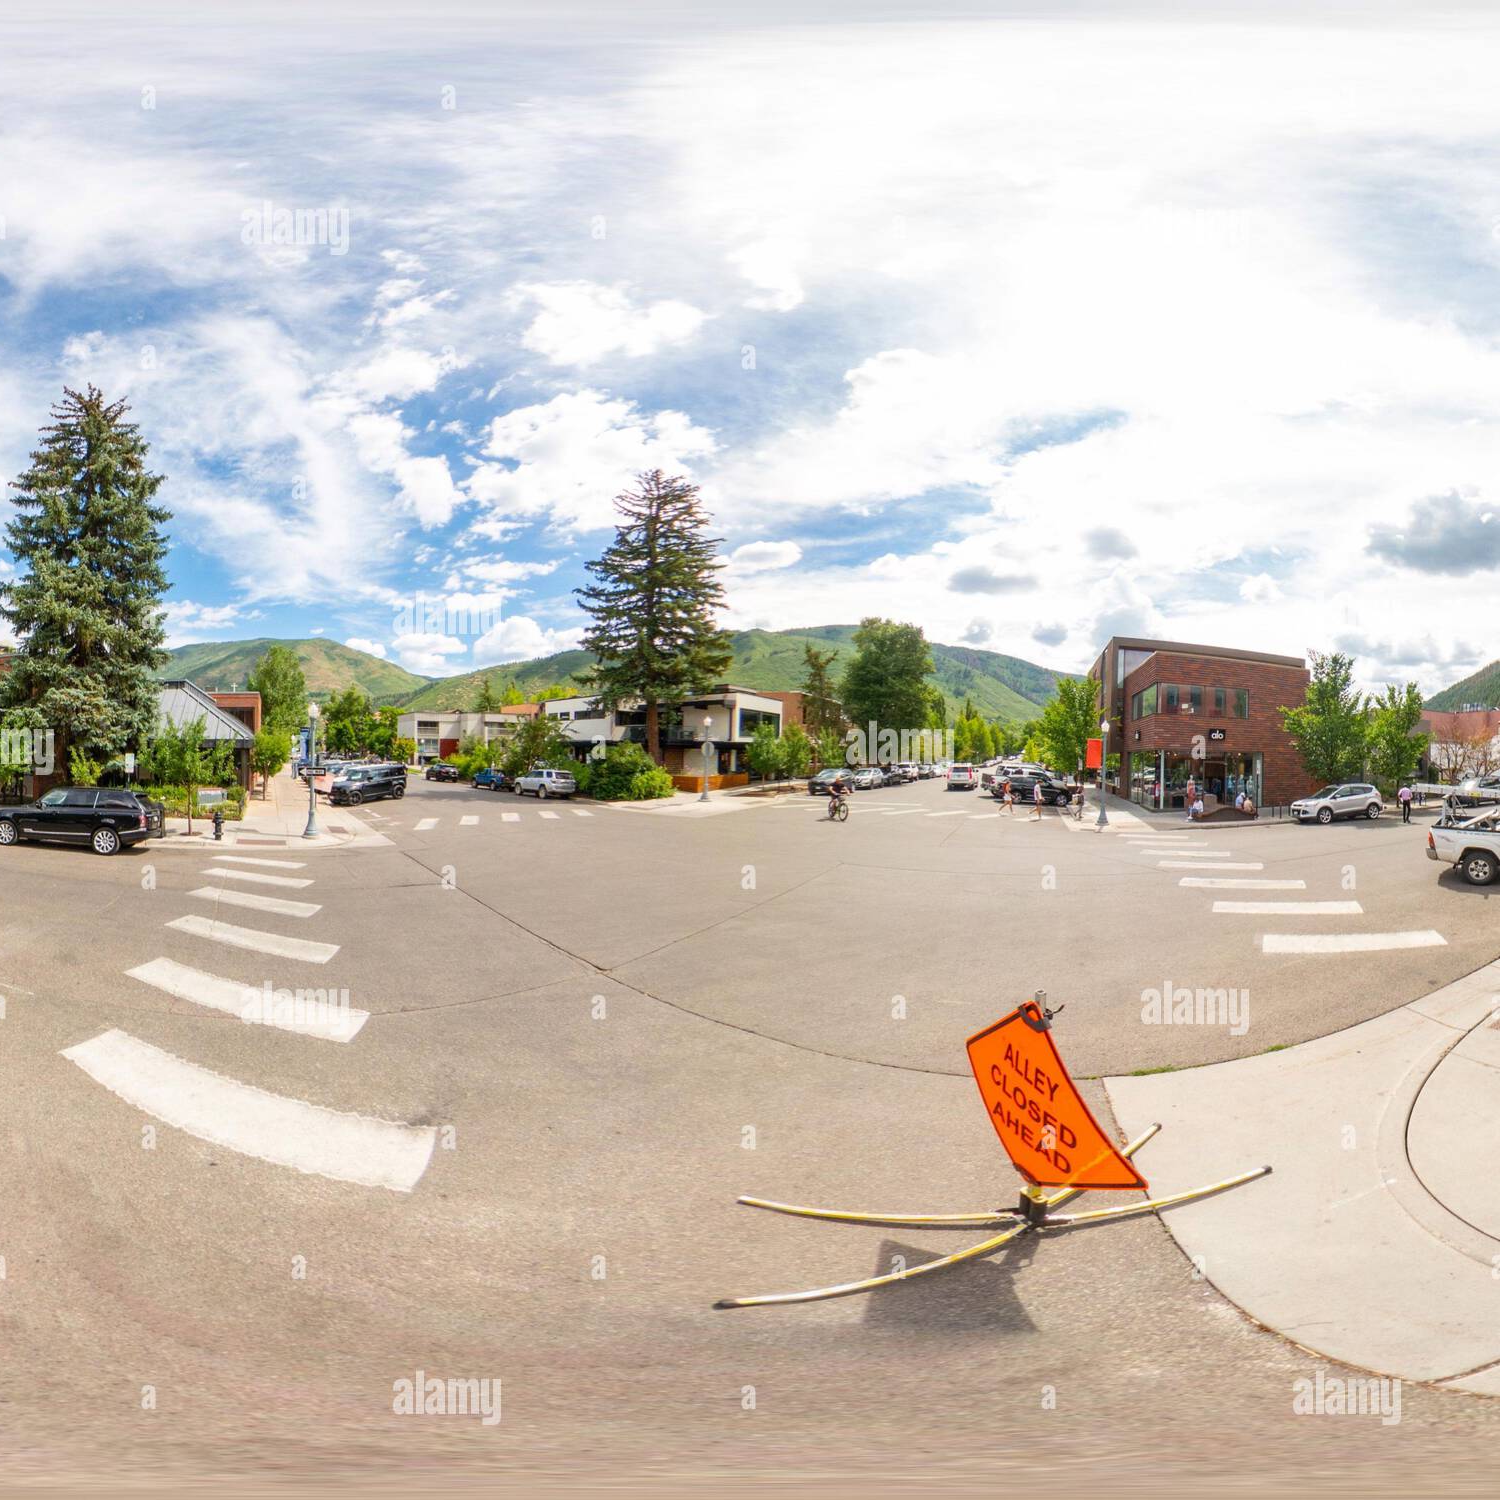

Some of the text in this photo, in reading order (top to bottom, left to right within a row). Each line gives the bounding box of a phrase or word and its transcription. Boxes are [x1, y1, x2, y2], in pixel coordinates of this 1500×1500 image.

[1211, 729, 1224, 740] alo
[1004, 1043, 1059, 1103] ALLEY
[991, 1064, 1077, 1149] CLOSED
[992, 1101, 1071, 1174] AHEAD
